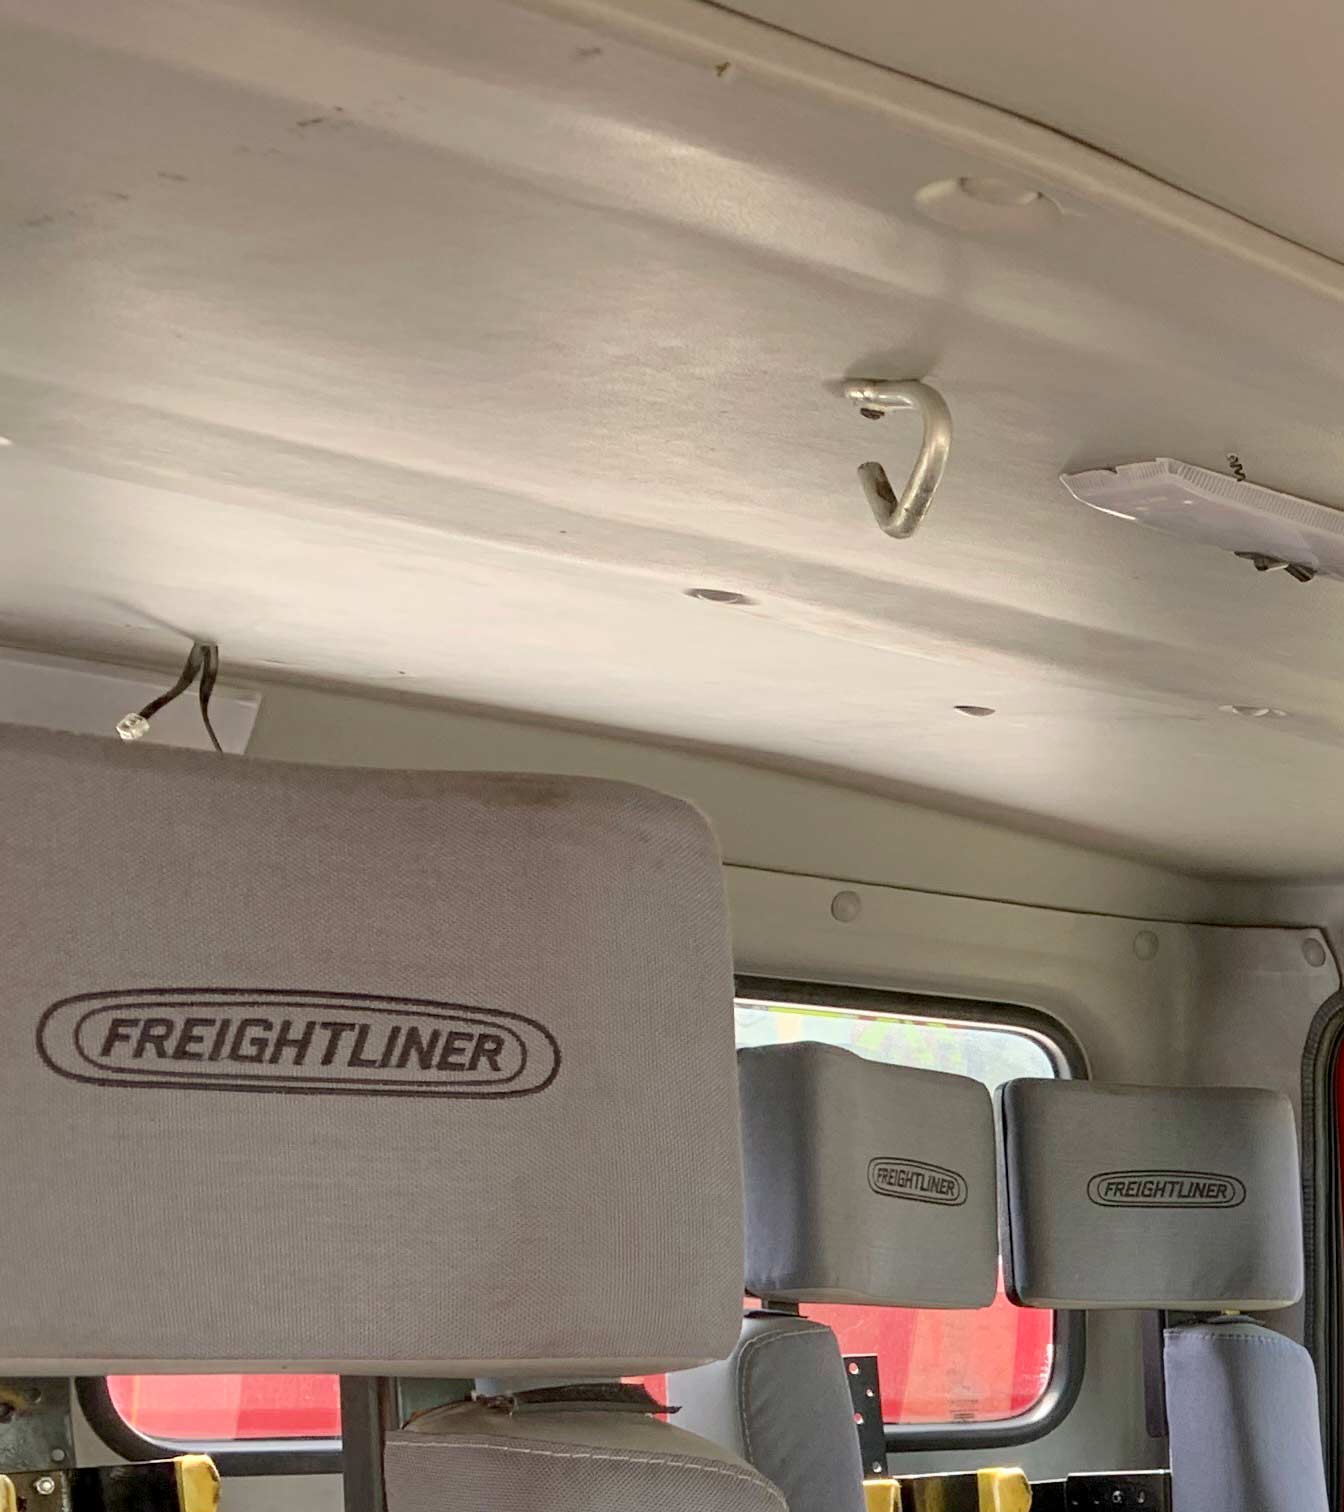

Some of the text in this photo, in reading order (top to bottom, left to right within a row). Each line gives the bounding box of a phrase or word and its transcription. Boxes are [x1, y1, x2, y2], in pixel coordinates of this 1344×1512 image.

[100, 1017, 505, 1072] FREIGHTLINER
[876, 1167, 955, 1197] FREIGHTLINER
[1104, 1180, 1229, 1200] FREIGHTLINER
